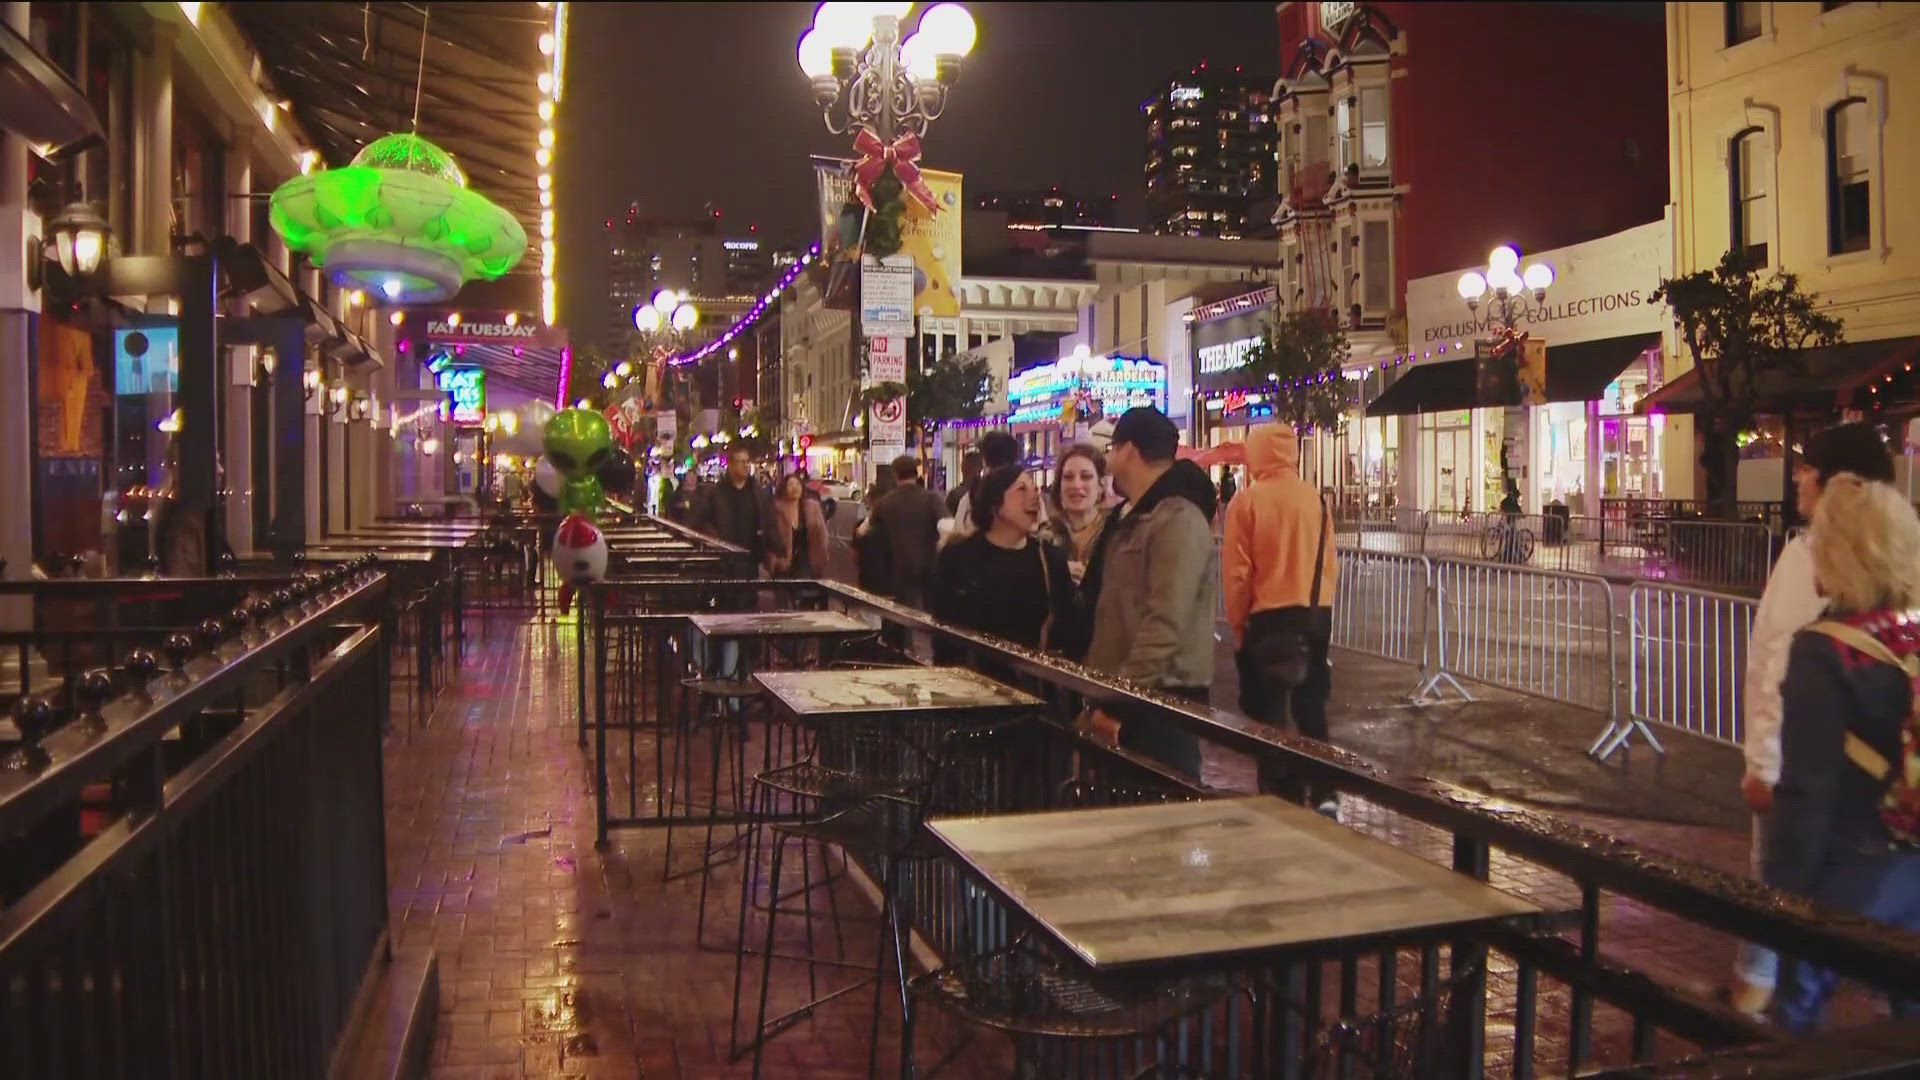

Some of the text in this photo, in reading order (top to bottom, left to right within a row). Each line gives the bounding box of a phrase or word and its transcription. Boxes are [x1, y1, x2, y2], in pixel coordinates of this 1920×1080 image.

[1425, 290, 1641, 342] EXCLUSIVE COLLECTIONS
[427, 321, 536, 337] FAT TUESDAY
[873, 338, 886, 351] NO
[872, 355, 904, 367] PARKING
